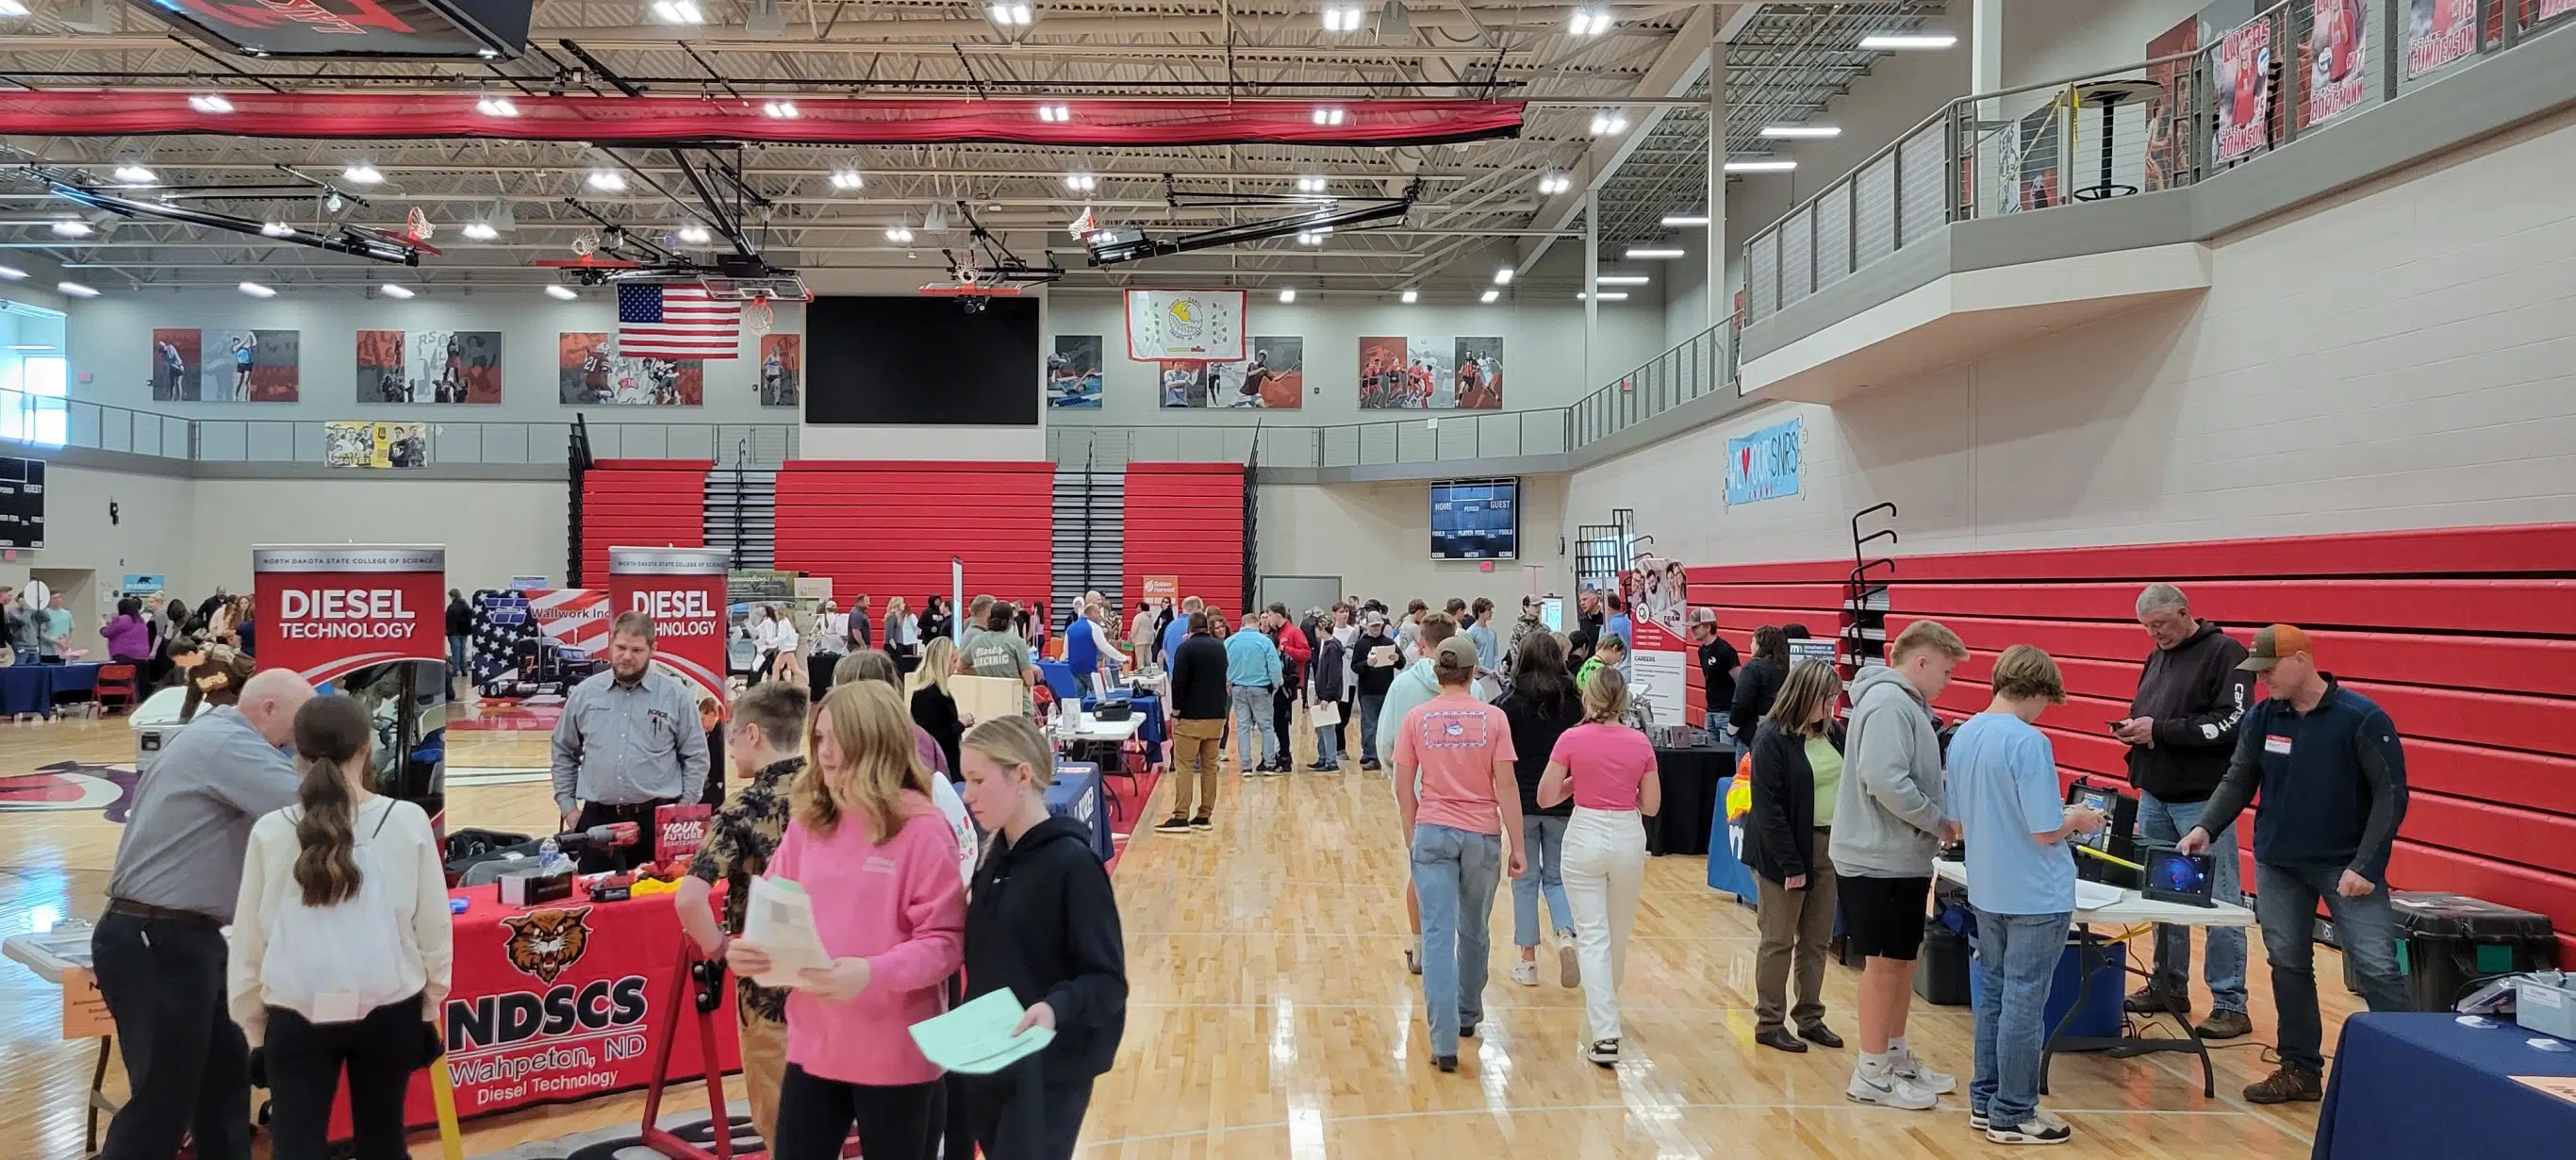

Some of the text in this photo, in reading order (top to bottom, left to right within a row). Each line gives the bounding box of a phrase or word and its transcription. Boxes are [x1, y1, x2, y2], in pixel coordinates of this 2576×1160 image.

[2408, 23, 2476, 76] GUNDERSON
[2410, 30, 2442, 48] GRACE
[2310, 75, 2364, 122] BORGMANN
[2219, 121, 2264, 160] JOHNSON
[281, 589, 416, 619] DIESEL
[531, 608, 589, 619] Wallwork
[633, 590, 717, 618] DIESEL
[279, 622, 417, 639] TECHNOLOGY
[654, 621, 717, 637] HNOLOGY
[663, 820, 704, 841] YOUR
[664, 833, 702, 841] FUTURE
[447, 975, 648, 1052] NDSCS
[449, 1035, 646, 1088] Wahpeton, ND
[477, 1070, 619, 1105] Diesel Technology
